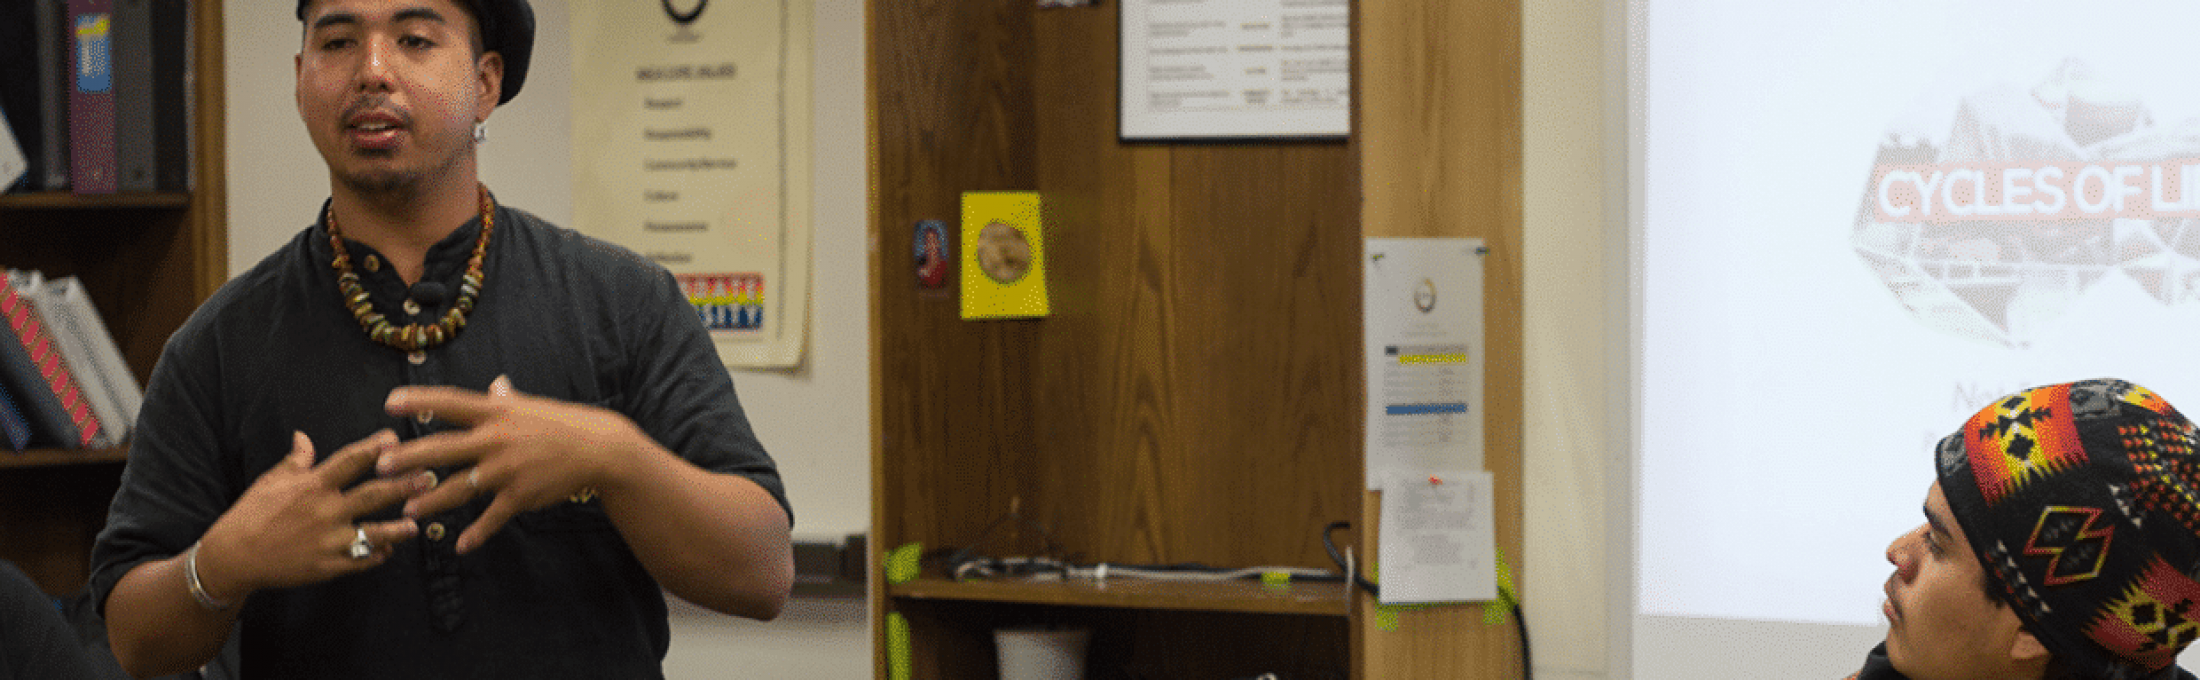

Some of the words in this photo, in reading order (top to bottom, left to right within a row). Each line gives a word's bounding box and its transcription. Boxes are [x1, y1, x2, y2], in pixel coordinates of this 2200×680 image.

[1878, 164, 2068, 218] CYCLES
[2072, 164, 2145, 214] OF
[2151, 164, 2200, 213] LI
[698, 302, 758, 327] SITY
